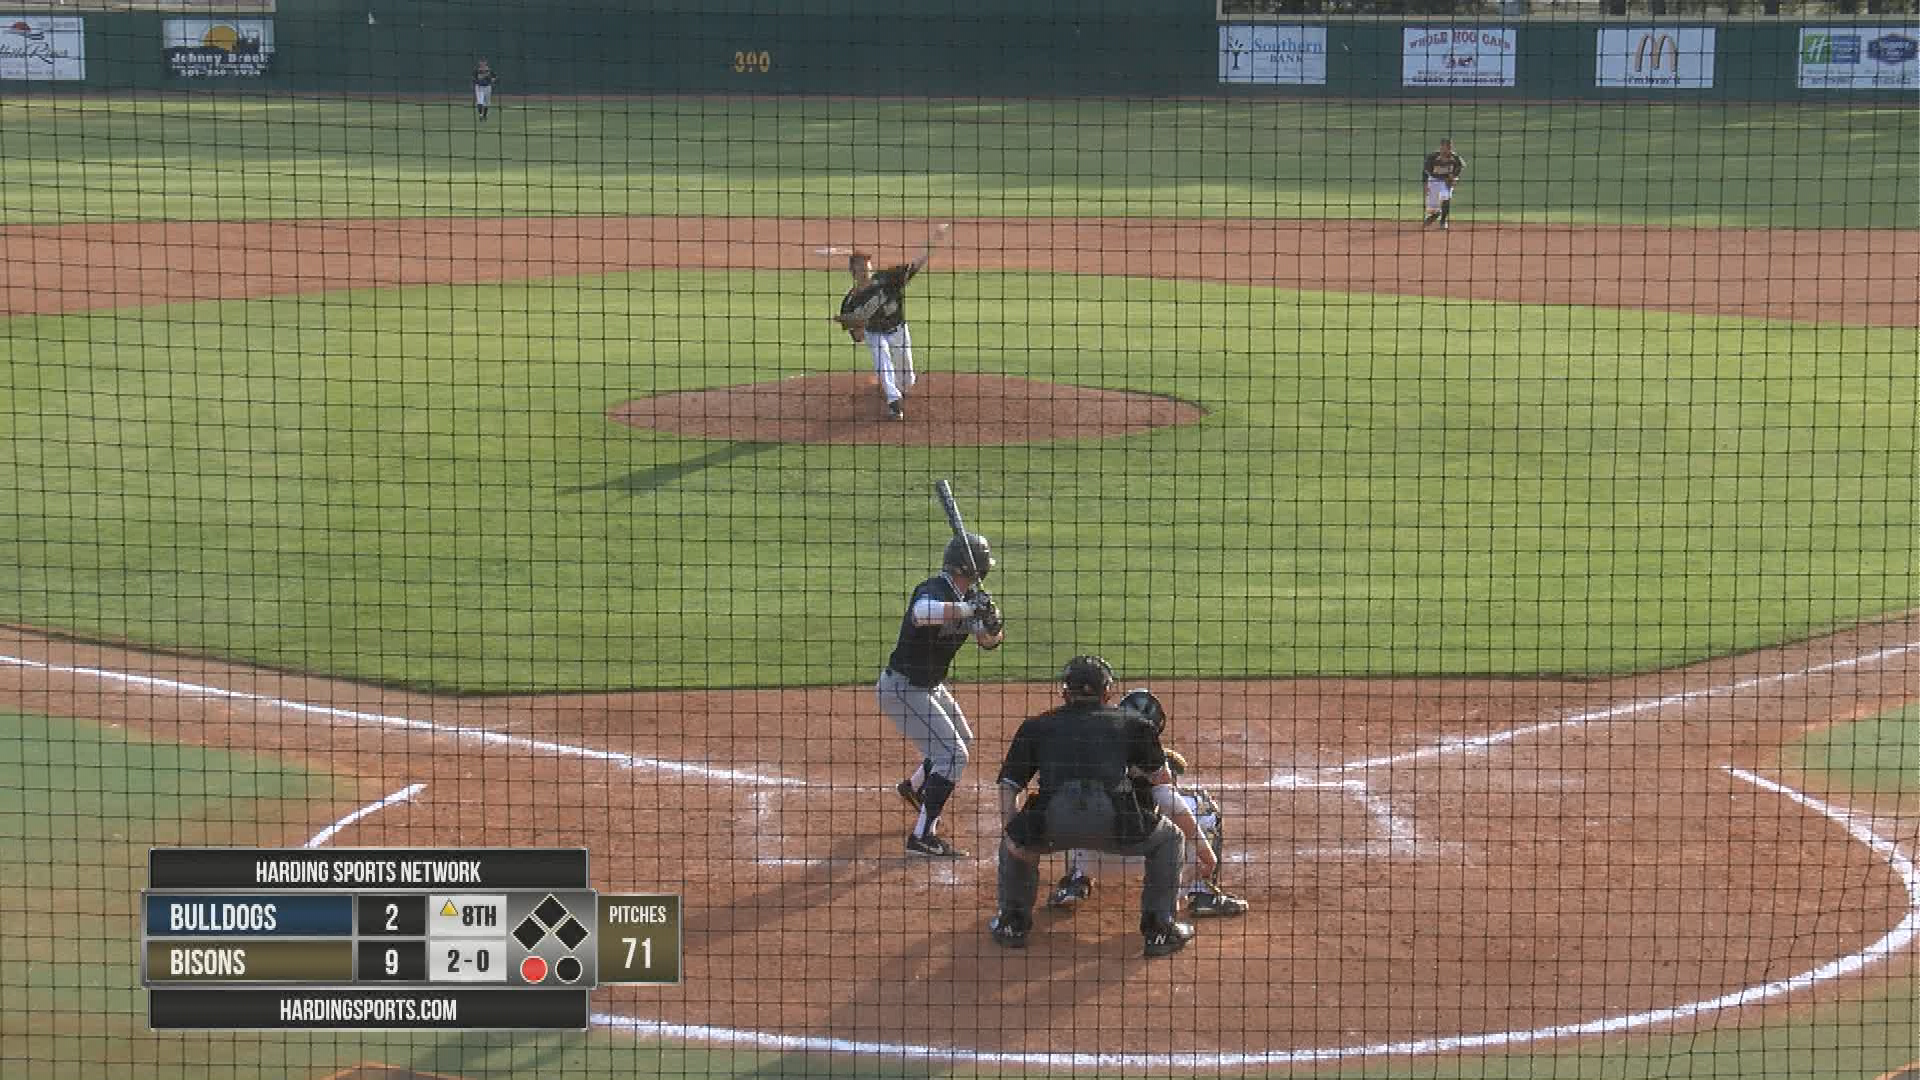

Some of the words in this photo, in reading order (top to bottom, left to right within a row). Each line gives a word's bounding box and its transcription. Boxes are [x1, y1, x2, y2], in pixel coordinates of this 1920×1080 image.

[1253, 37, 1323, 54] Southern
[171, 53, 223, 67] Johnny
[735, 51, 769, 73] 390
[1269, 53, 1304, 63] BANK
